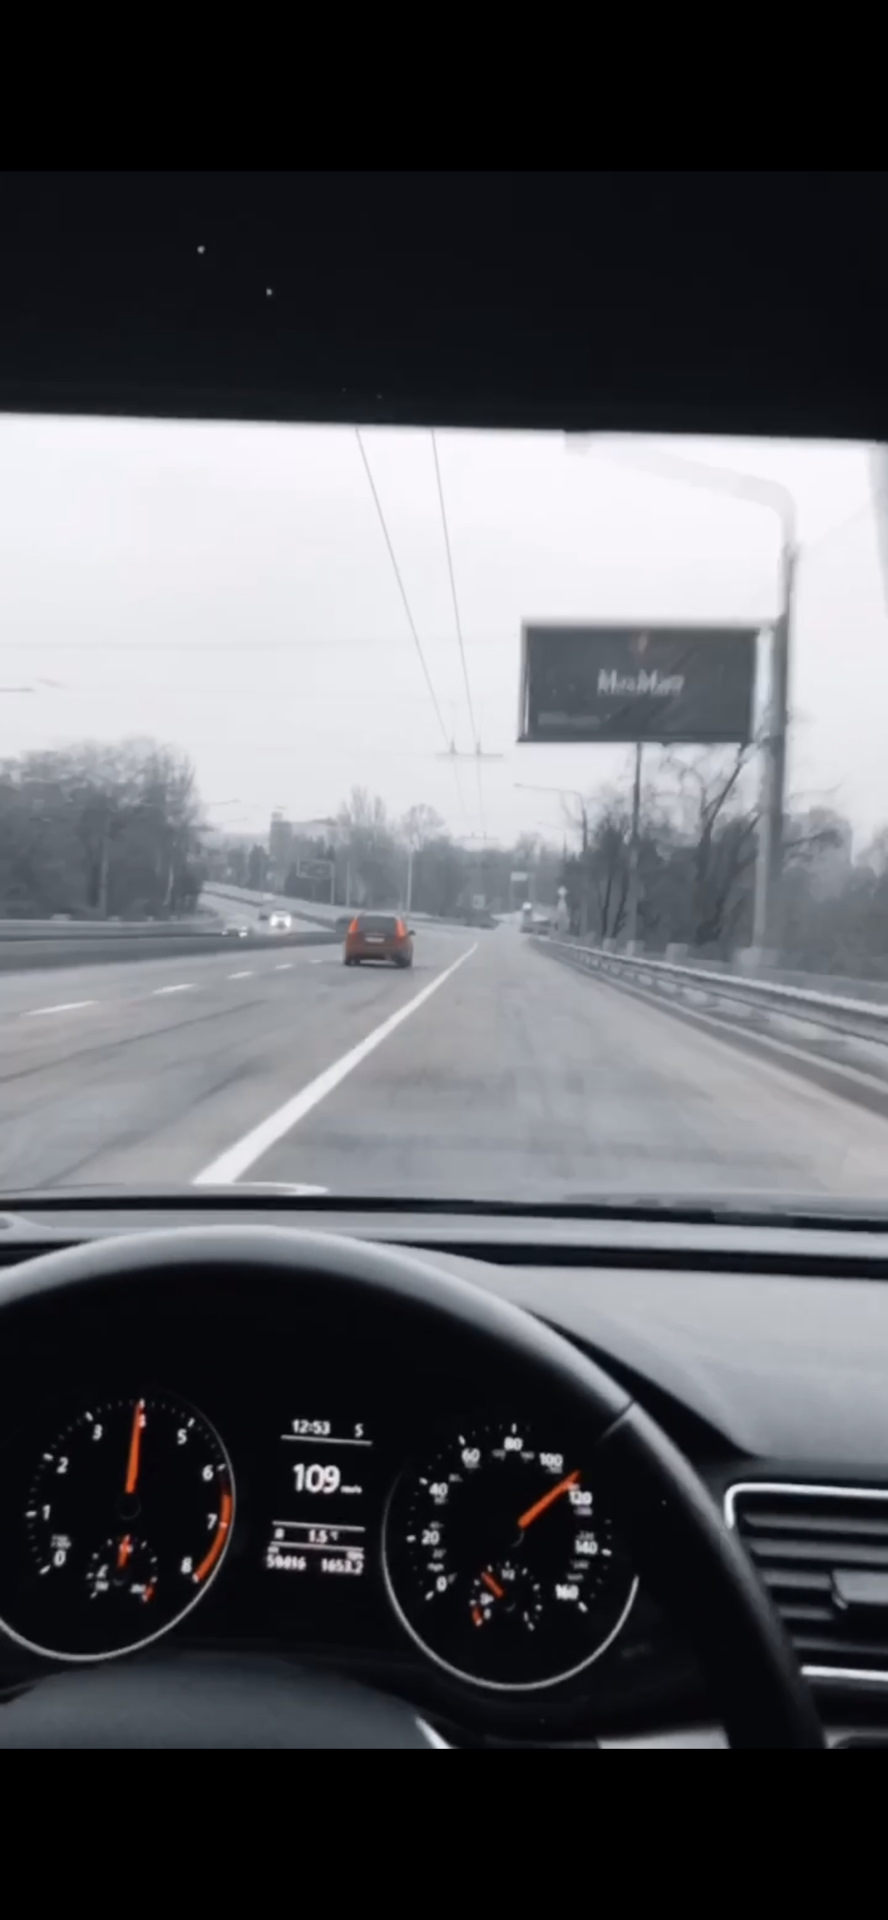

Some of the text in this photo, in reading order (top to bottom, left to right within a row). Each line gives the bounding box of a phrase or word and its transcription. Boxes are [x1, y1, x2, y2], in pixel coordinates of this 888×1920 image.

[92, 1424, 103, 1441] 3
[292, 1418, 331, 1436] 12:53
[176, 1429, 187, 1445] 5
[503, 1436, 523, 1451] 80
[461, 1448, 481, 1463] 60
[539, 1453, 563, 1467] 100
[56, 1457, 69, 1474] 2
[202, 1464, 214, 1481] 6
[293, 1463, 340, 1493] 109
[429, 1482, 449, 1497] 40
[43, 1504, 51, 1520] 1
[207, 1513, 218, 1530] 7
[421, 1529, 440, 1546] 20
[575, 1540, 598, 1555] 140
[54, 1550, 67, 1568] 0
[181, 1557, 193, 1575] 8
[436, 1575, 448, 1593] 0
